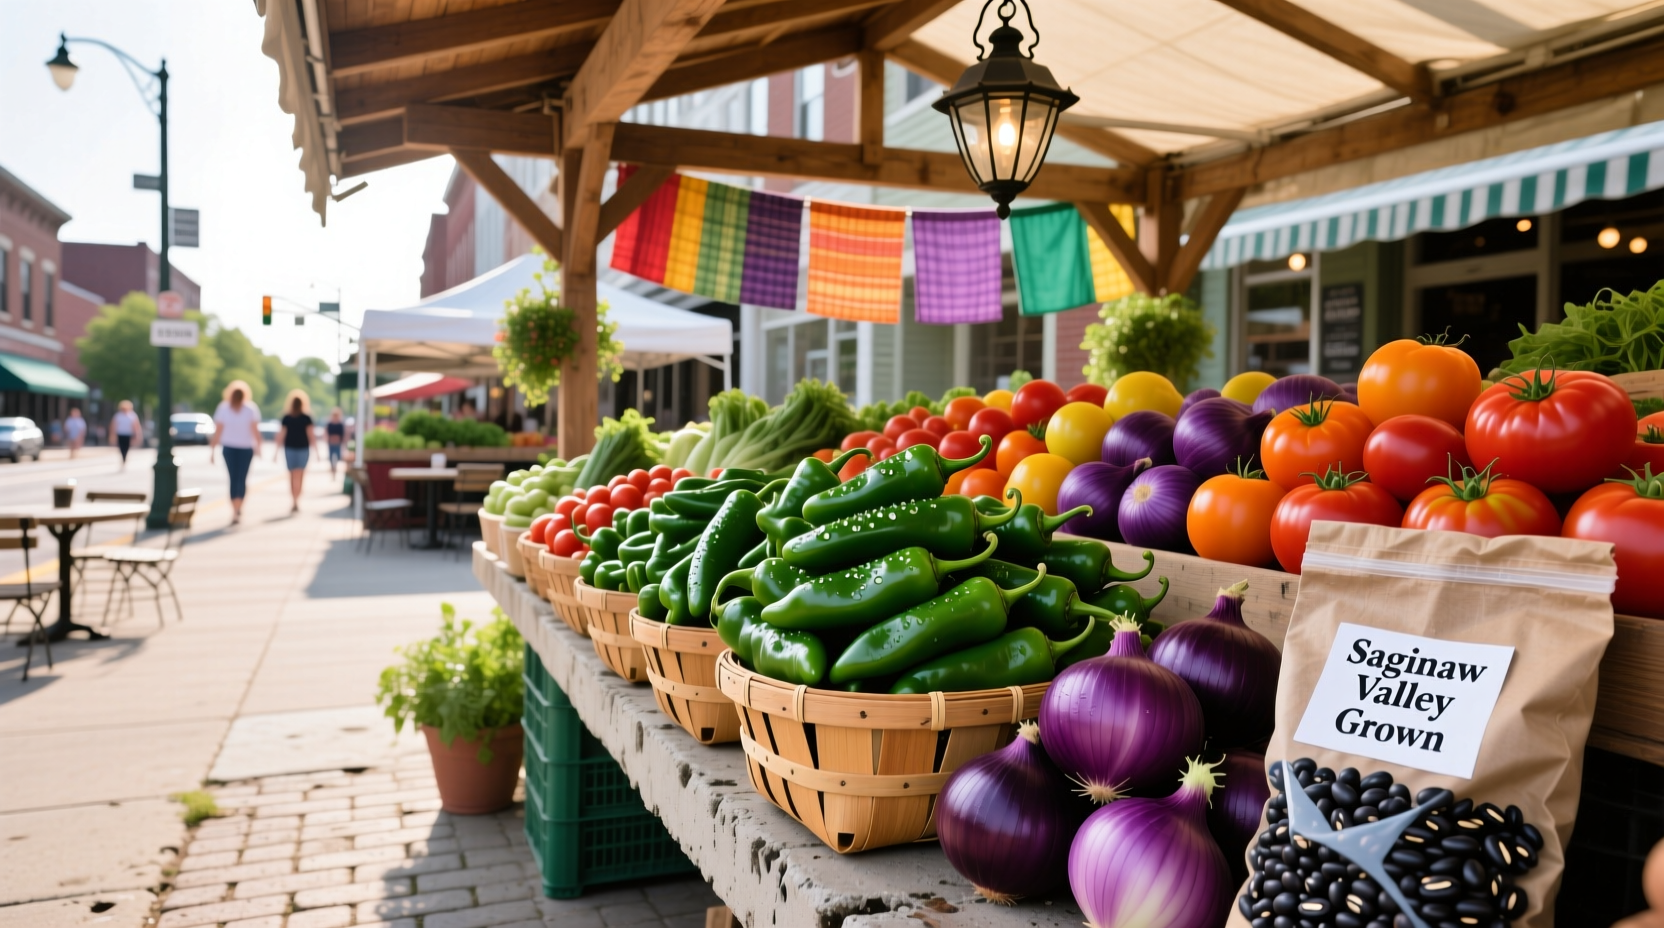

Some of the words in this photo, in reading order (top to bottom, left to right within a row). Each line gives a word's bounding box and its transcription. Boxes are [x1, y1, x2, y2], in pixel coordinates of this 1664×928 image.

[1347, 639, 1487, 682] Saginaw
[1357, 674, 1455, 721] Valley
[1335, 708, 1444, 752] Grown
